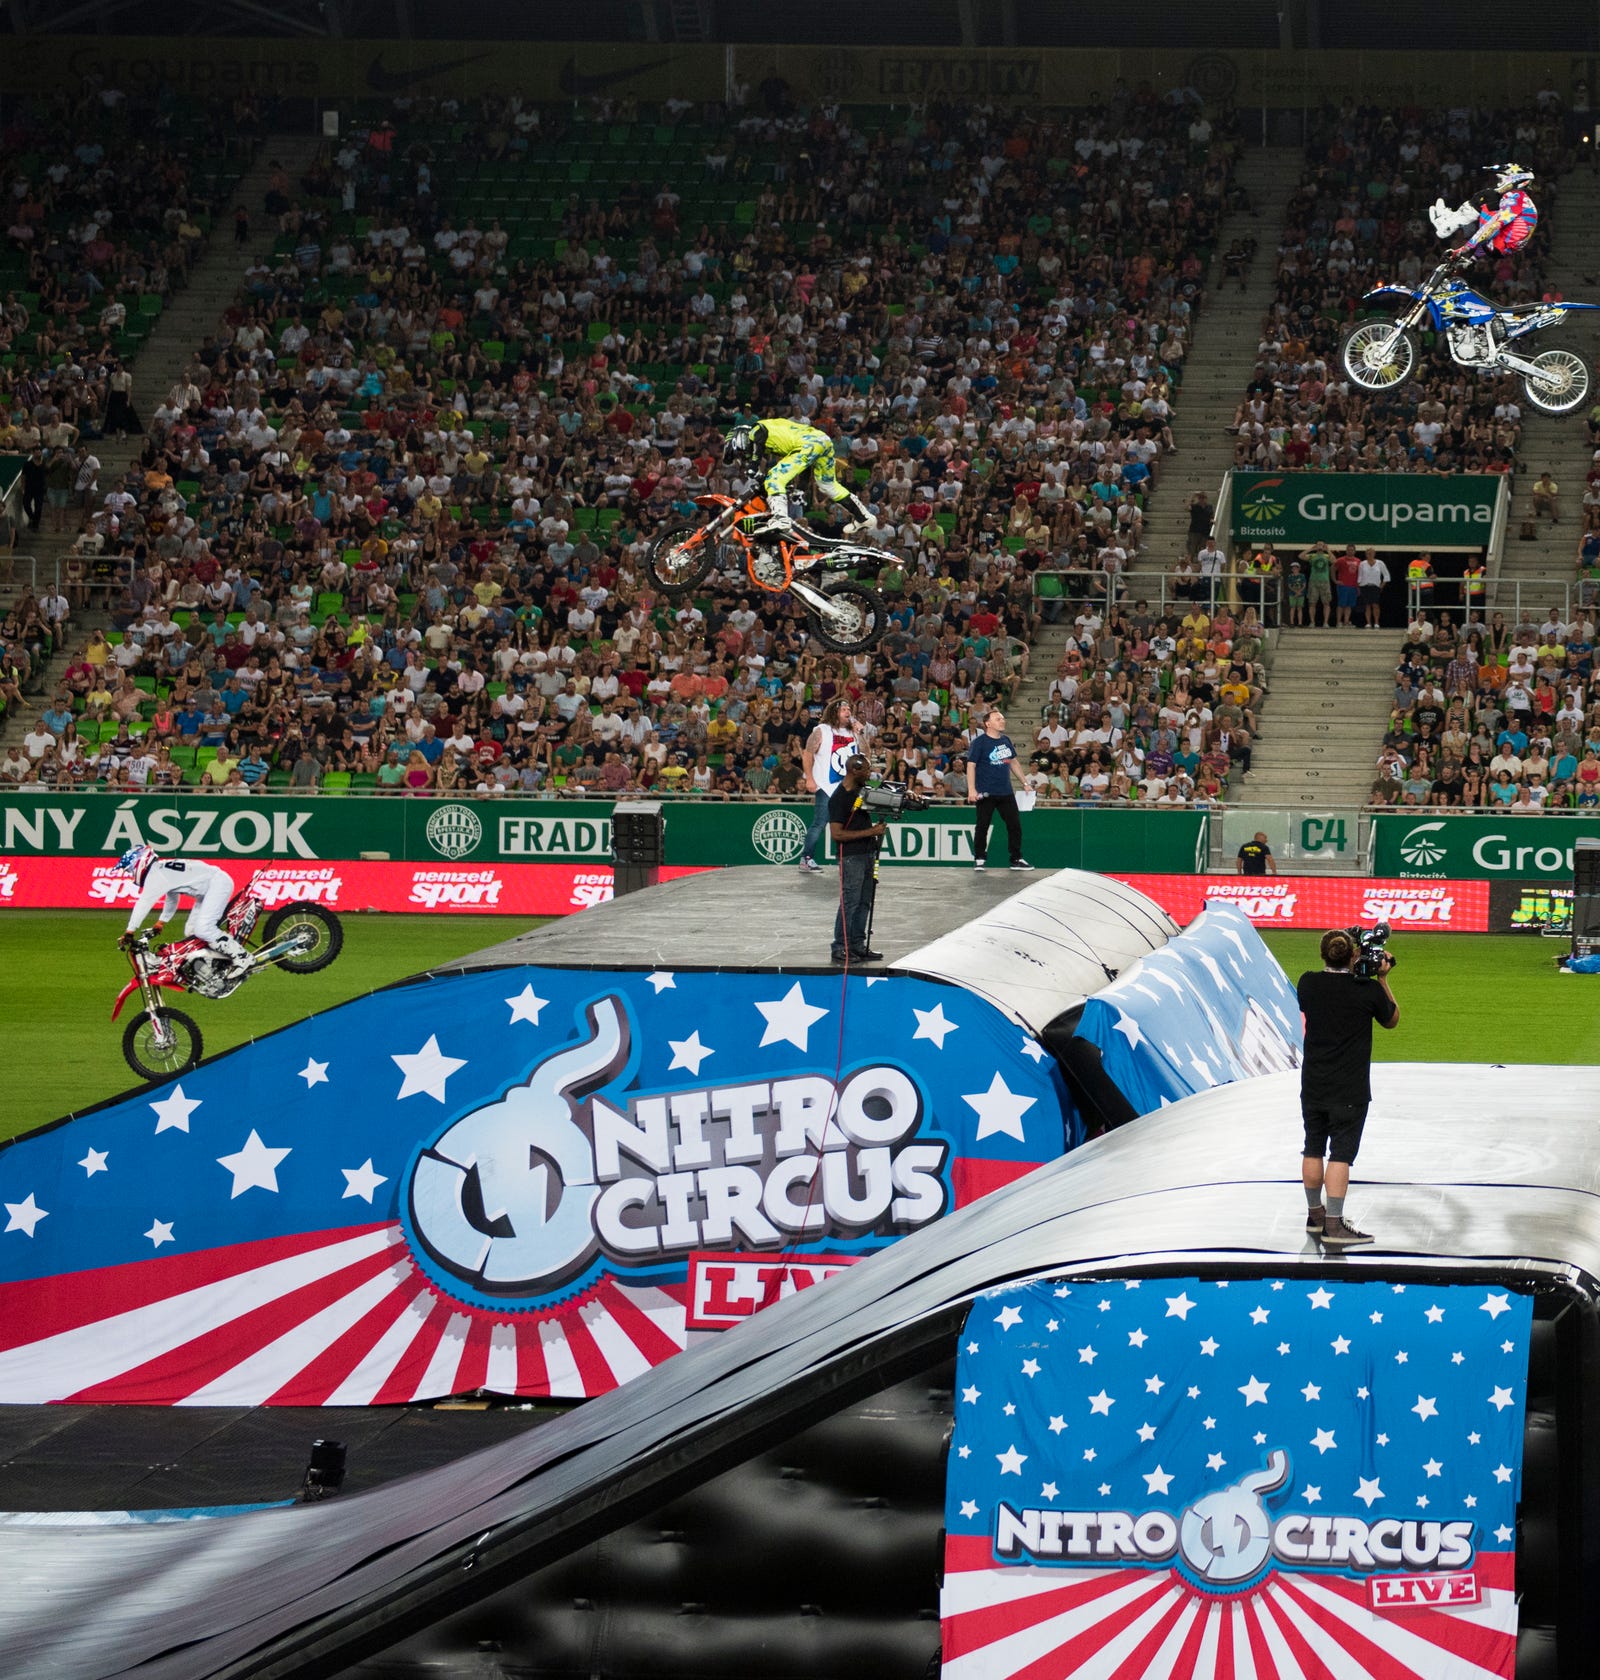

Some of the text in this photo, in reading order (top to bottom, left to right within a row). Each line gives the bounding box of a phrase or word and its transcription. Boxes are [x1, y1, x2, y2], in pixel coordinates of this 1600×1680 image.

[1298, 493, 1492, 528] Groupama
[0, 799, 319, 859] NY ÁSZOK
[504, 819, 612, 853] FRADI
[879, 827, 936, 857] ADI
[1301, 818, 1347, 852] C4
[252, 866, 334, 880] nemzeti
[413, 870, 495, 883] nemzeti
[246, 875, 342, 905] sport
[408, 880, 503, 908] sport
[1206, 884, 1288, 897] nemzeti
[1363, 887, 1446, 900] nemzeti
[1360, 894, 1455, 922] sport
[592, 1066, 919, 1182] NITRO
[598, 1145, 947, 1252] CIRCUS
[703, 1267, 842, 1315] LI
[998, 1503, 1474, 1567] NITRO CIRCUS
[1376, 1576, 1474, 1604] LIVE
